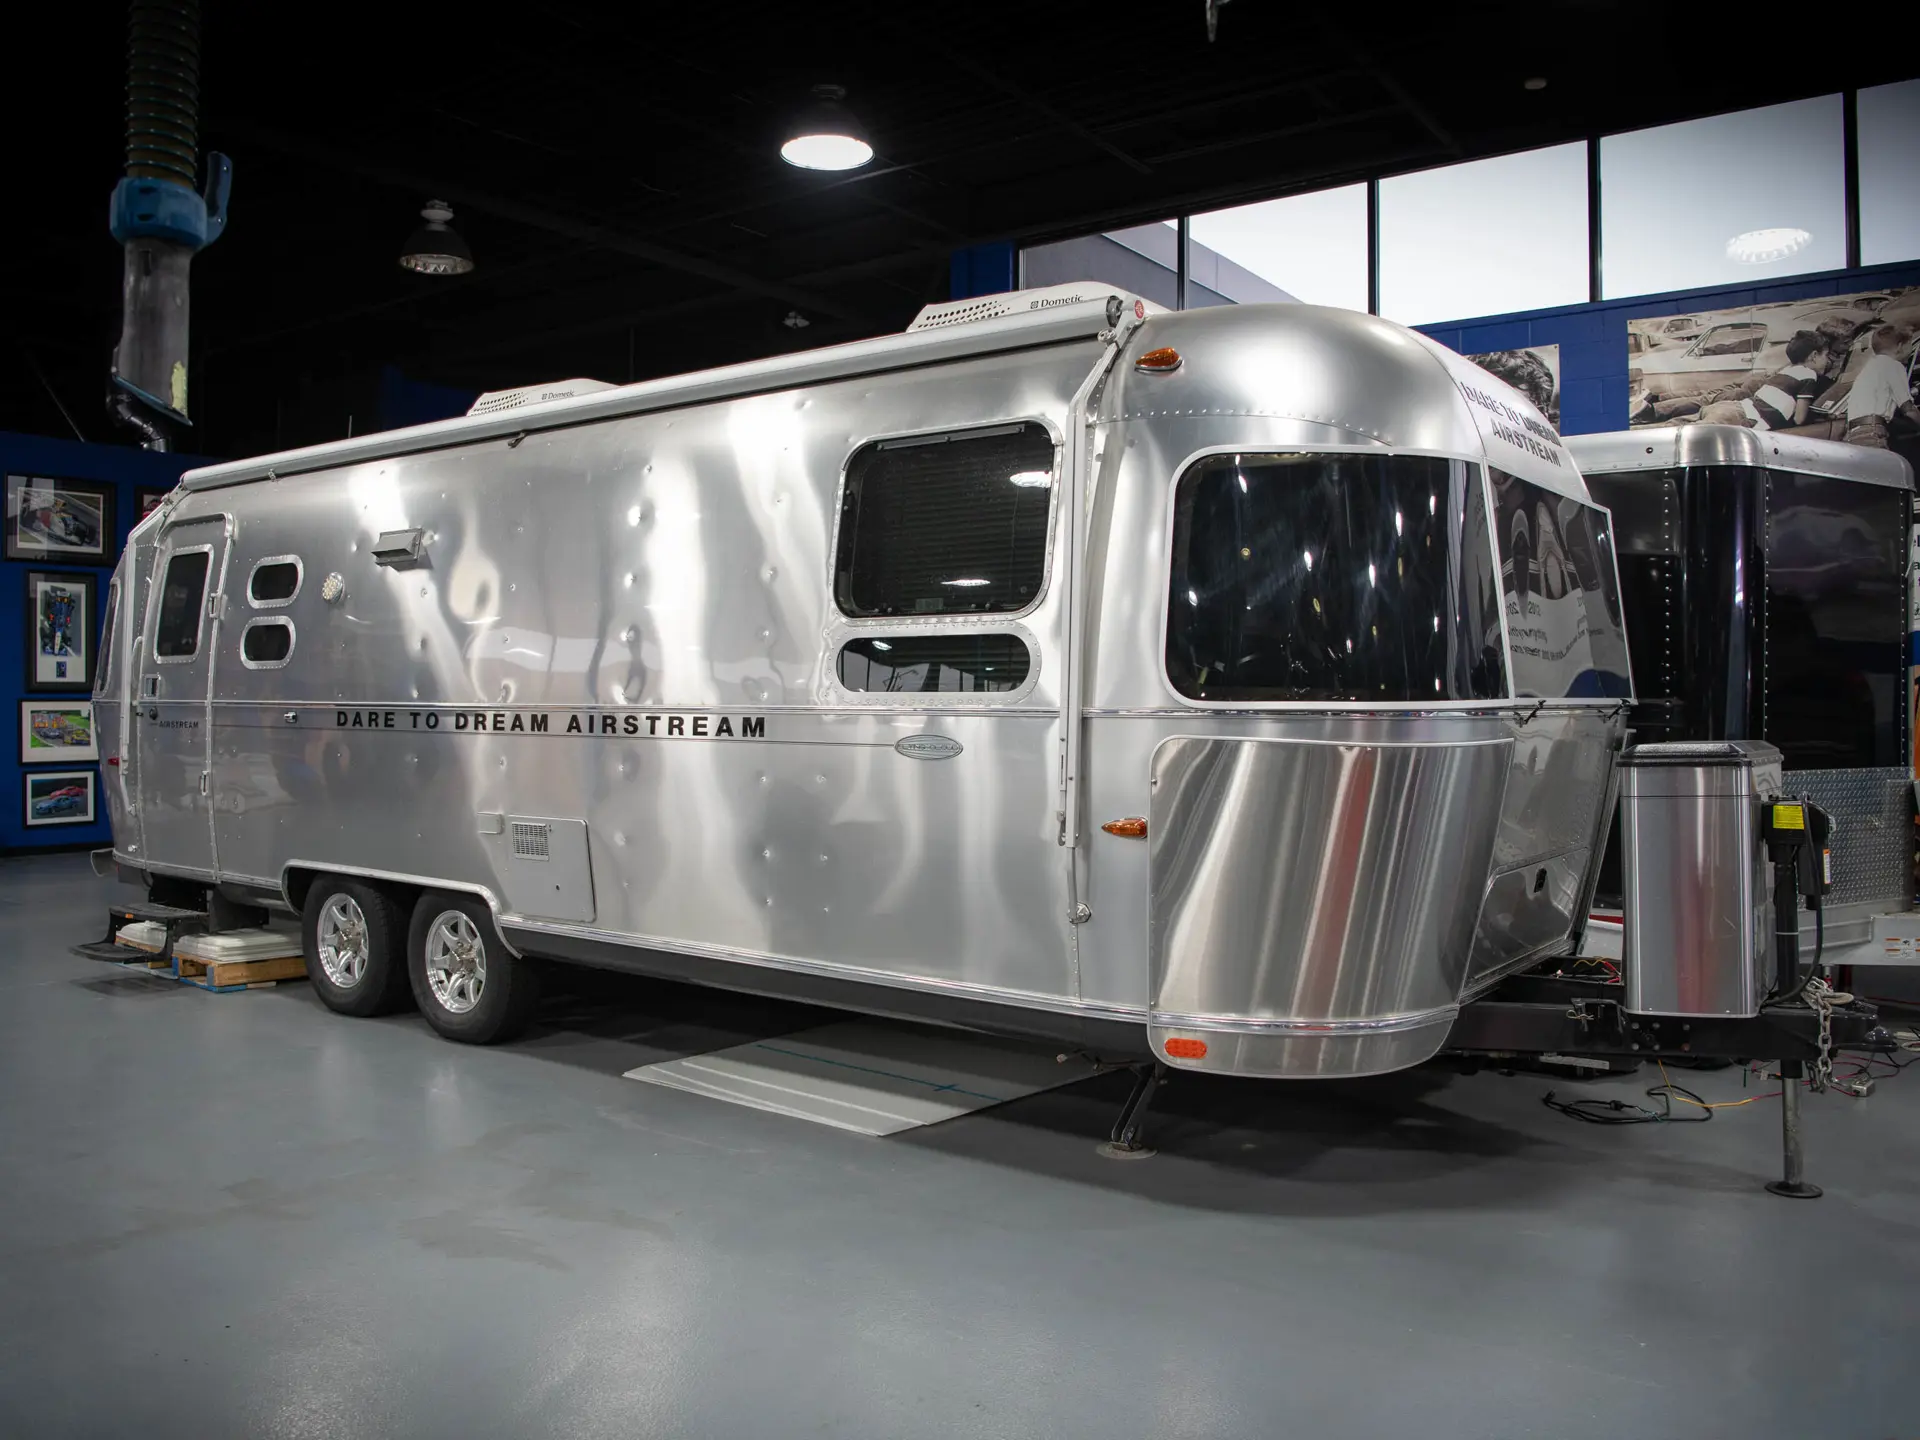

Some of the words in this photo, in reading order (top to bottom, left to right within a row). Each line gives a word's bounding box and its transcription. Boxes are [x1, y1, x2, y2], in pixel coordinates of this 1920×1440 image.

[1041, 294, 1084, 308] Dometic
[1490, 417, 1562, 468] AIRSTREAM
[158, 720, 199, 729] AIRSTREAM
[336, 710, 396, 729] DARE
[409, 711, 440, 730] TO
[455, 712, 549, 733] DREAM
[566, 714, 766, 739] AIRSTREAM
